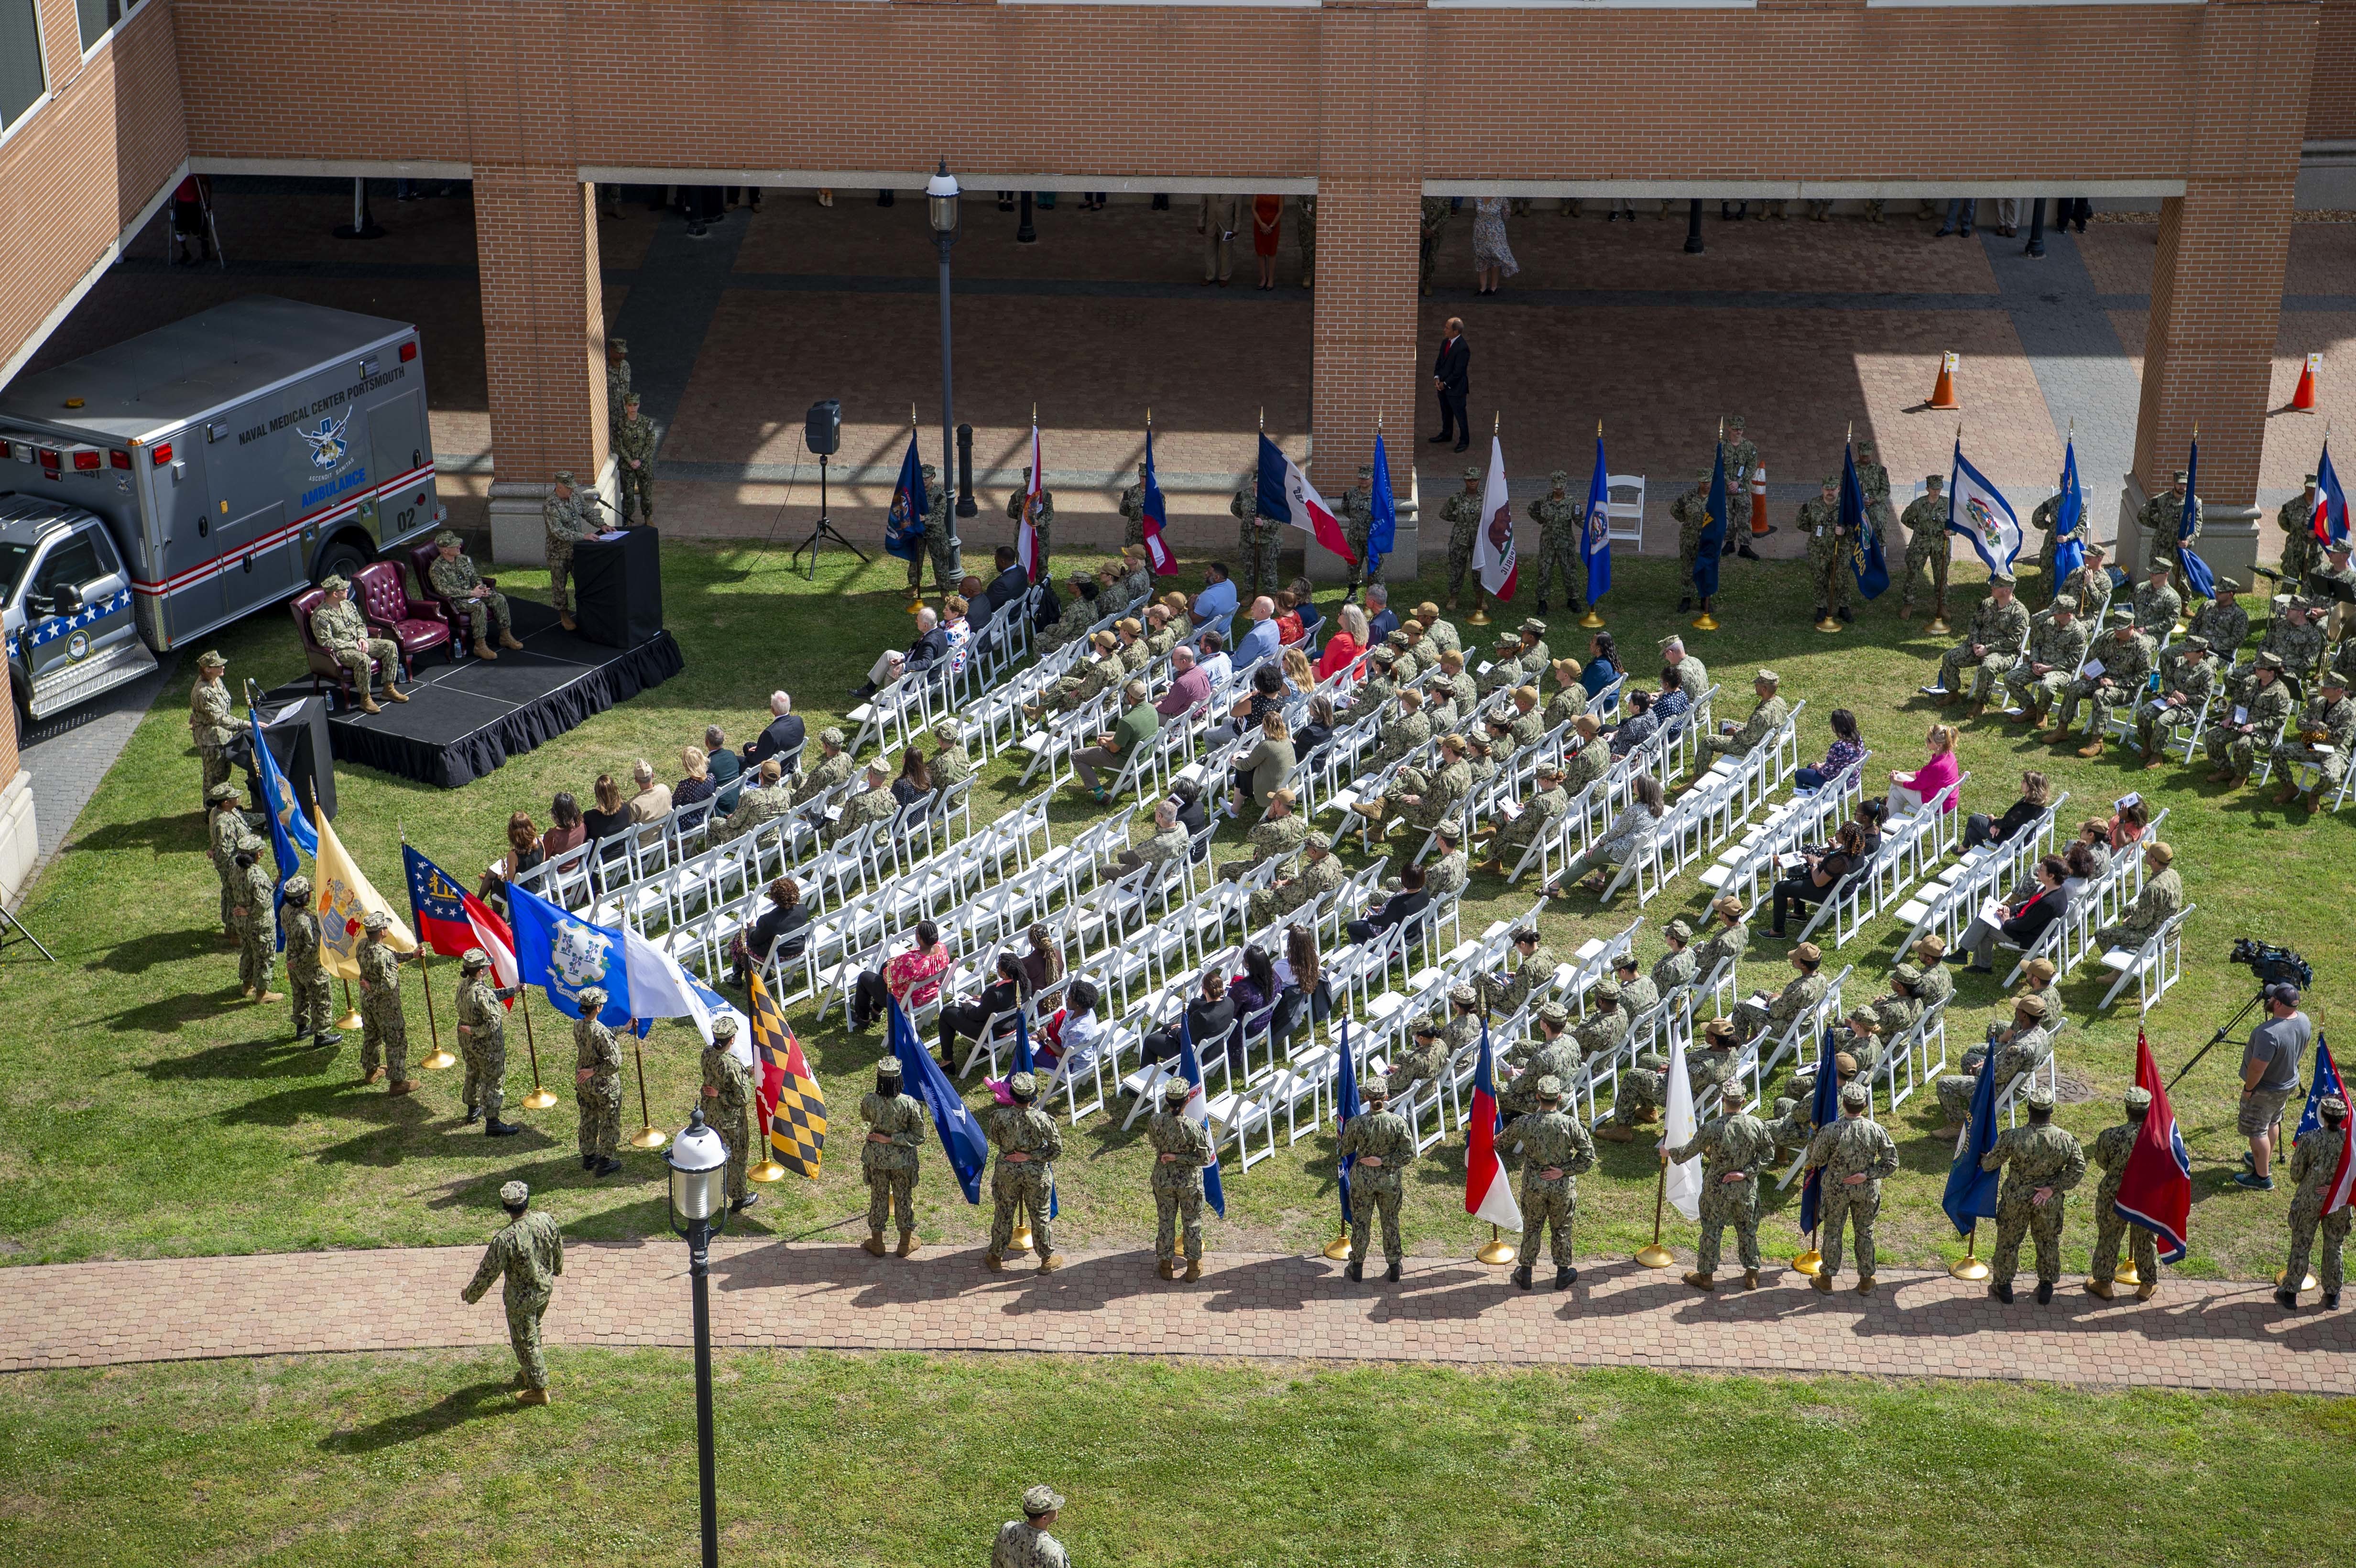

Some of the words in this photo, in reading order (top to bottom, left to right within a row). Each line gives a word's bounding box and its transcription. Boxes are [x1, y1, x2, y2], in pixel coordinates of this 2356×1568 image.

[239, 424, 267, 446] NAVAL
[269, 406, 309, 433] MEDICAL
[311, 392, 346, 415] CENTER
[348, 366, 405, 401] PORTSMOUTH
[302, 468, 366, 509] AMBULANCE
[309, 472, 332, 482] ASCENDIT
[336, 457, 355, 475] SANITAS
[397, 508, 416, 533] 02
[1853, 522, 1866, 577] KNSAS
